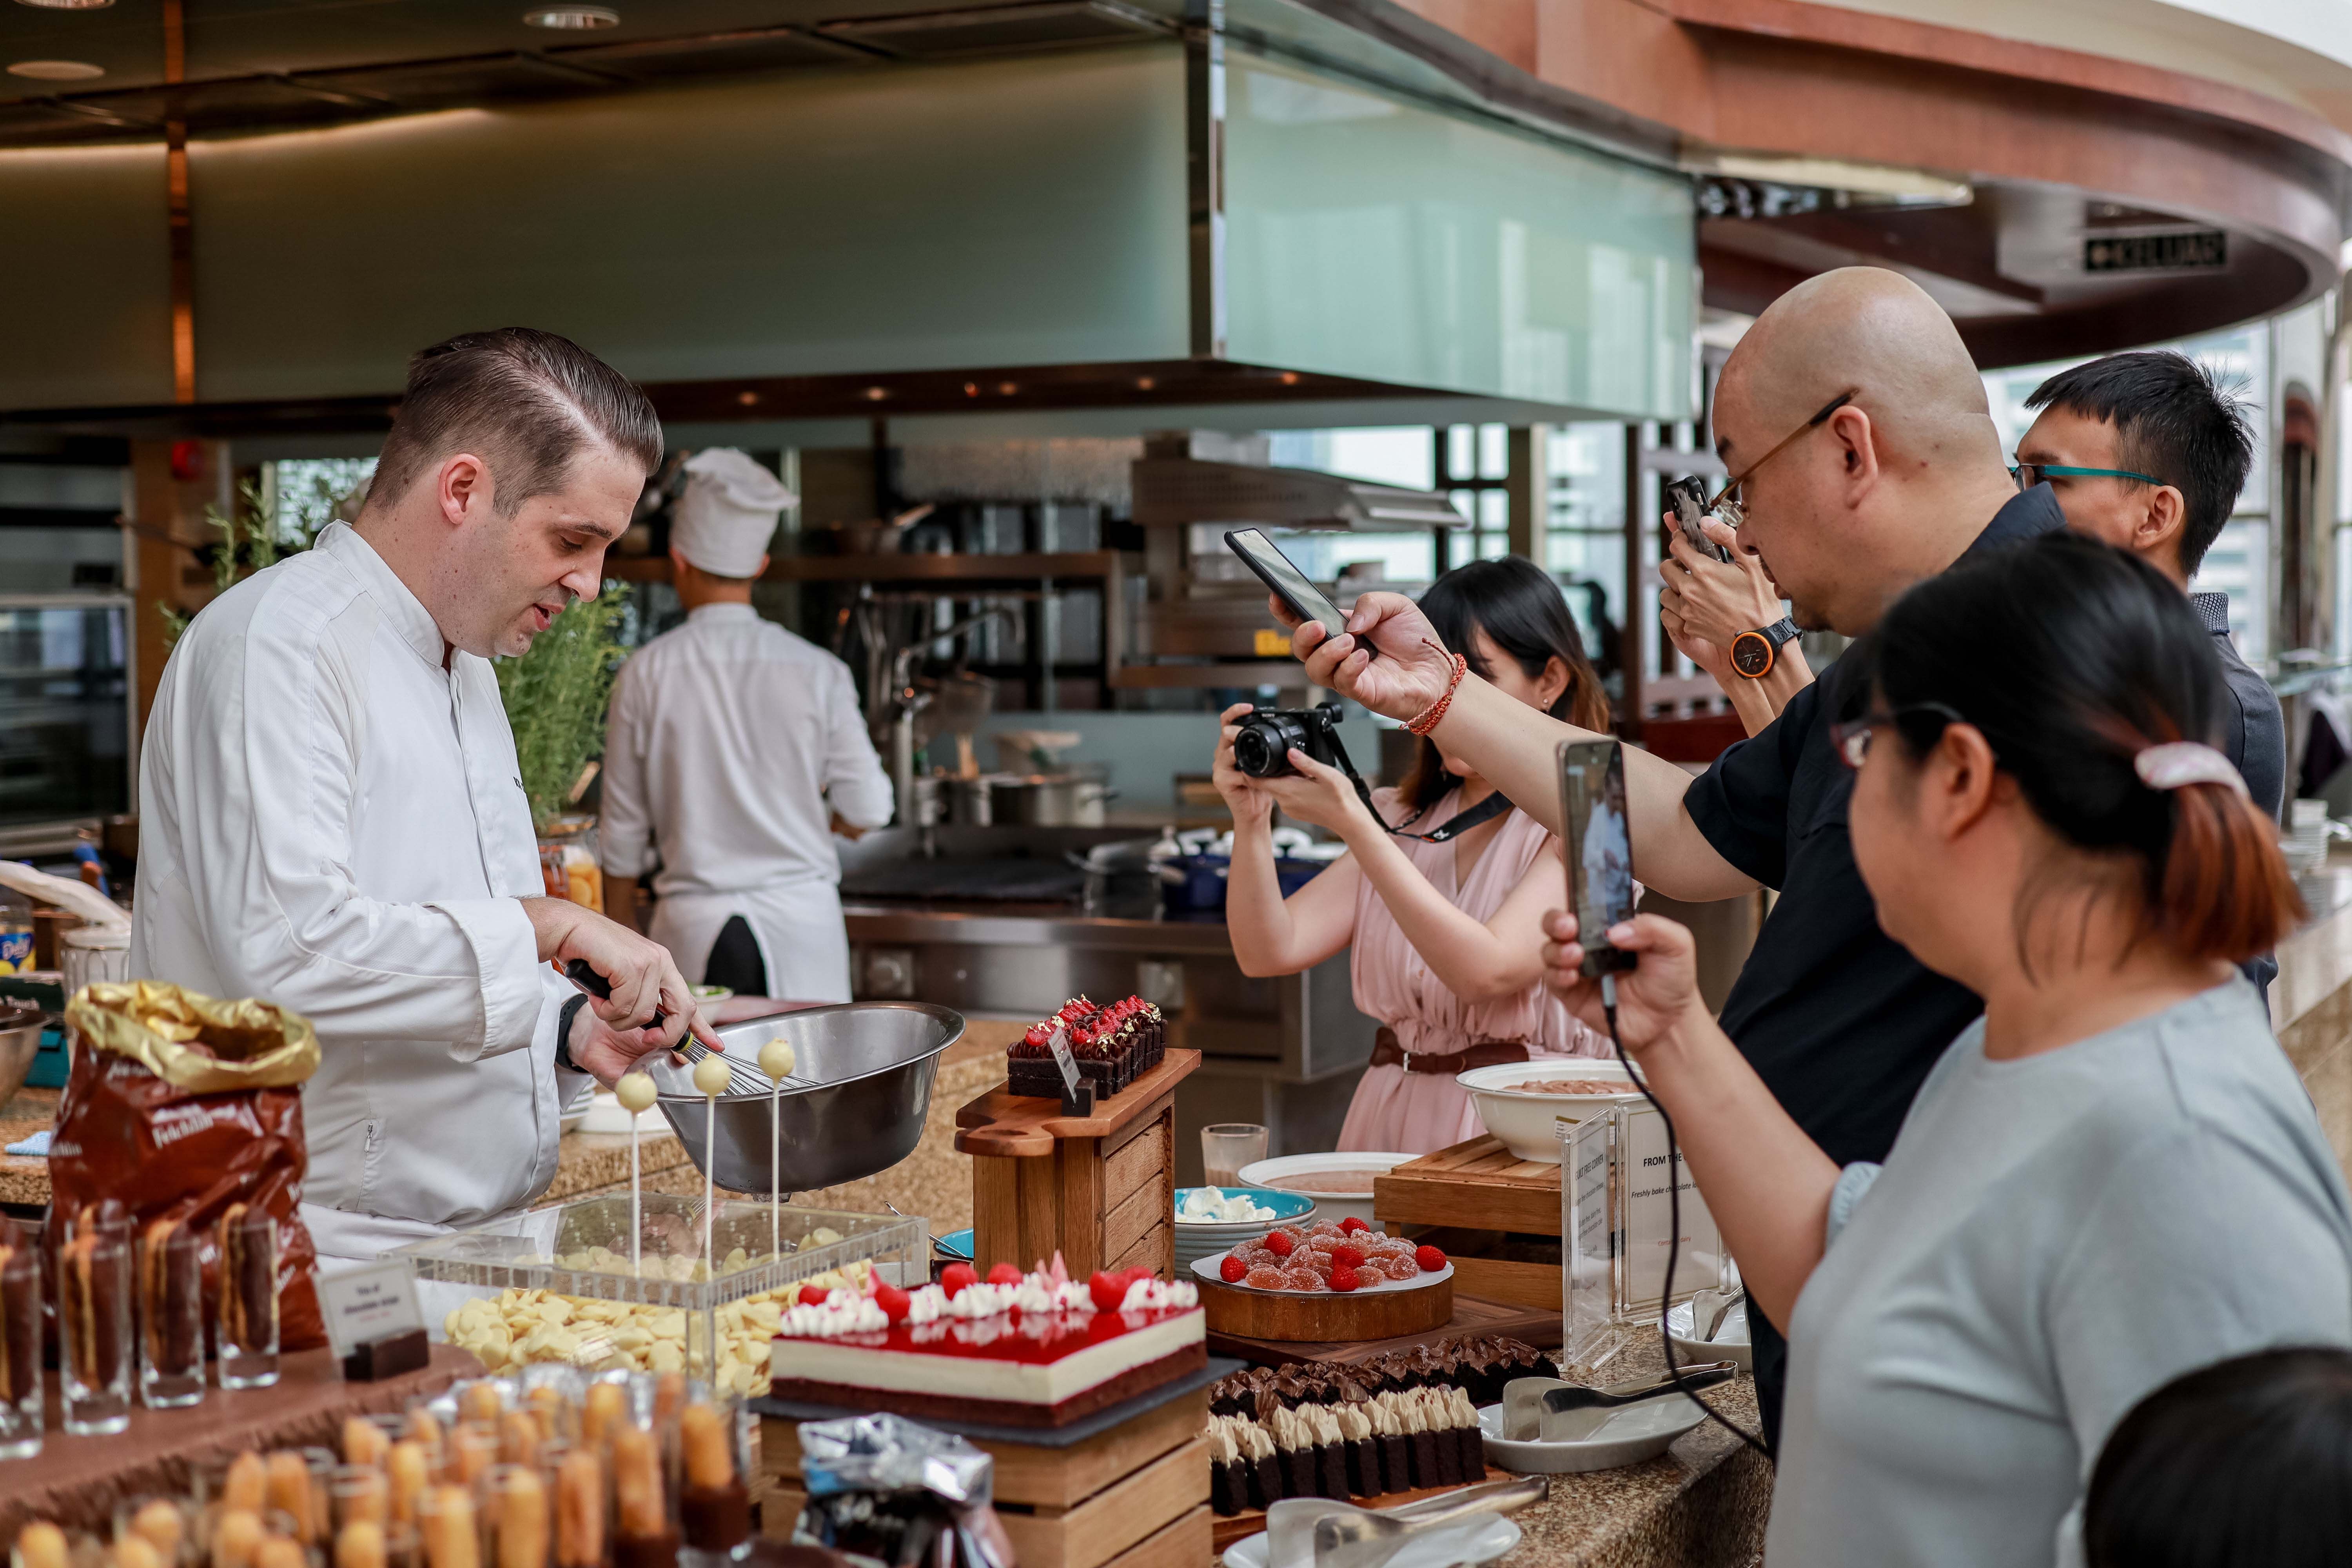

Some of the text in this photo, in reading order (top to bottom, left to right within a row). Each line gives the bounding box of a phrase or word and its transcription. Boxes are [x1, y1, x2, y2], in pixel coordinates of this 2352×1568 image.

[1592, 1154, 1603, 1170] CORNER
[1643, 1155, 1666, 1167] FROM
[1631, 1189, 1651, 1198] Freshly
[1651, 1187, 1664, 1196] bake
[1666, 1183, 1691, 1193] chcolate
